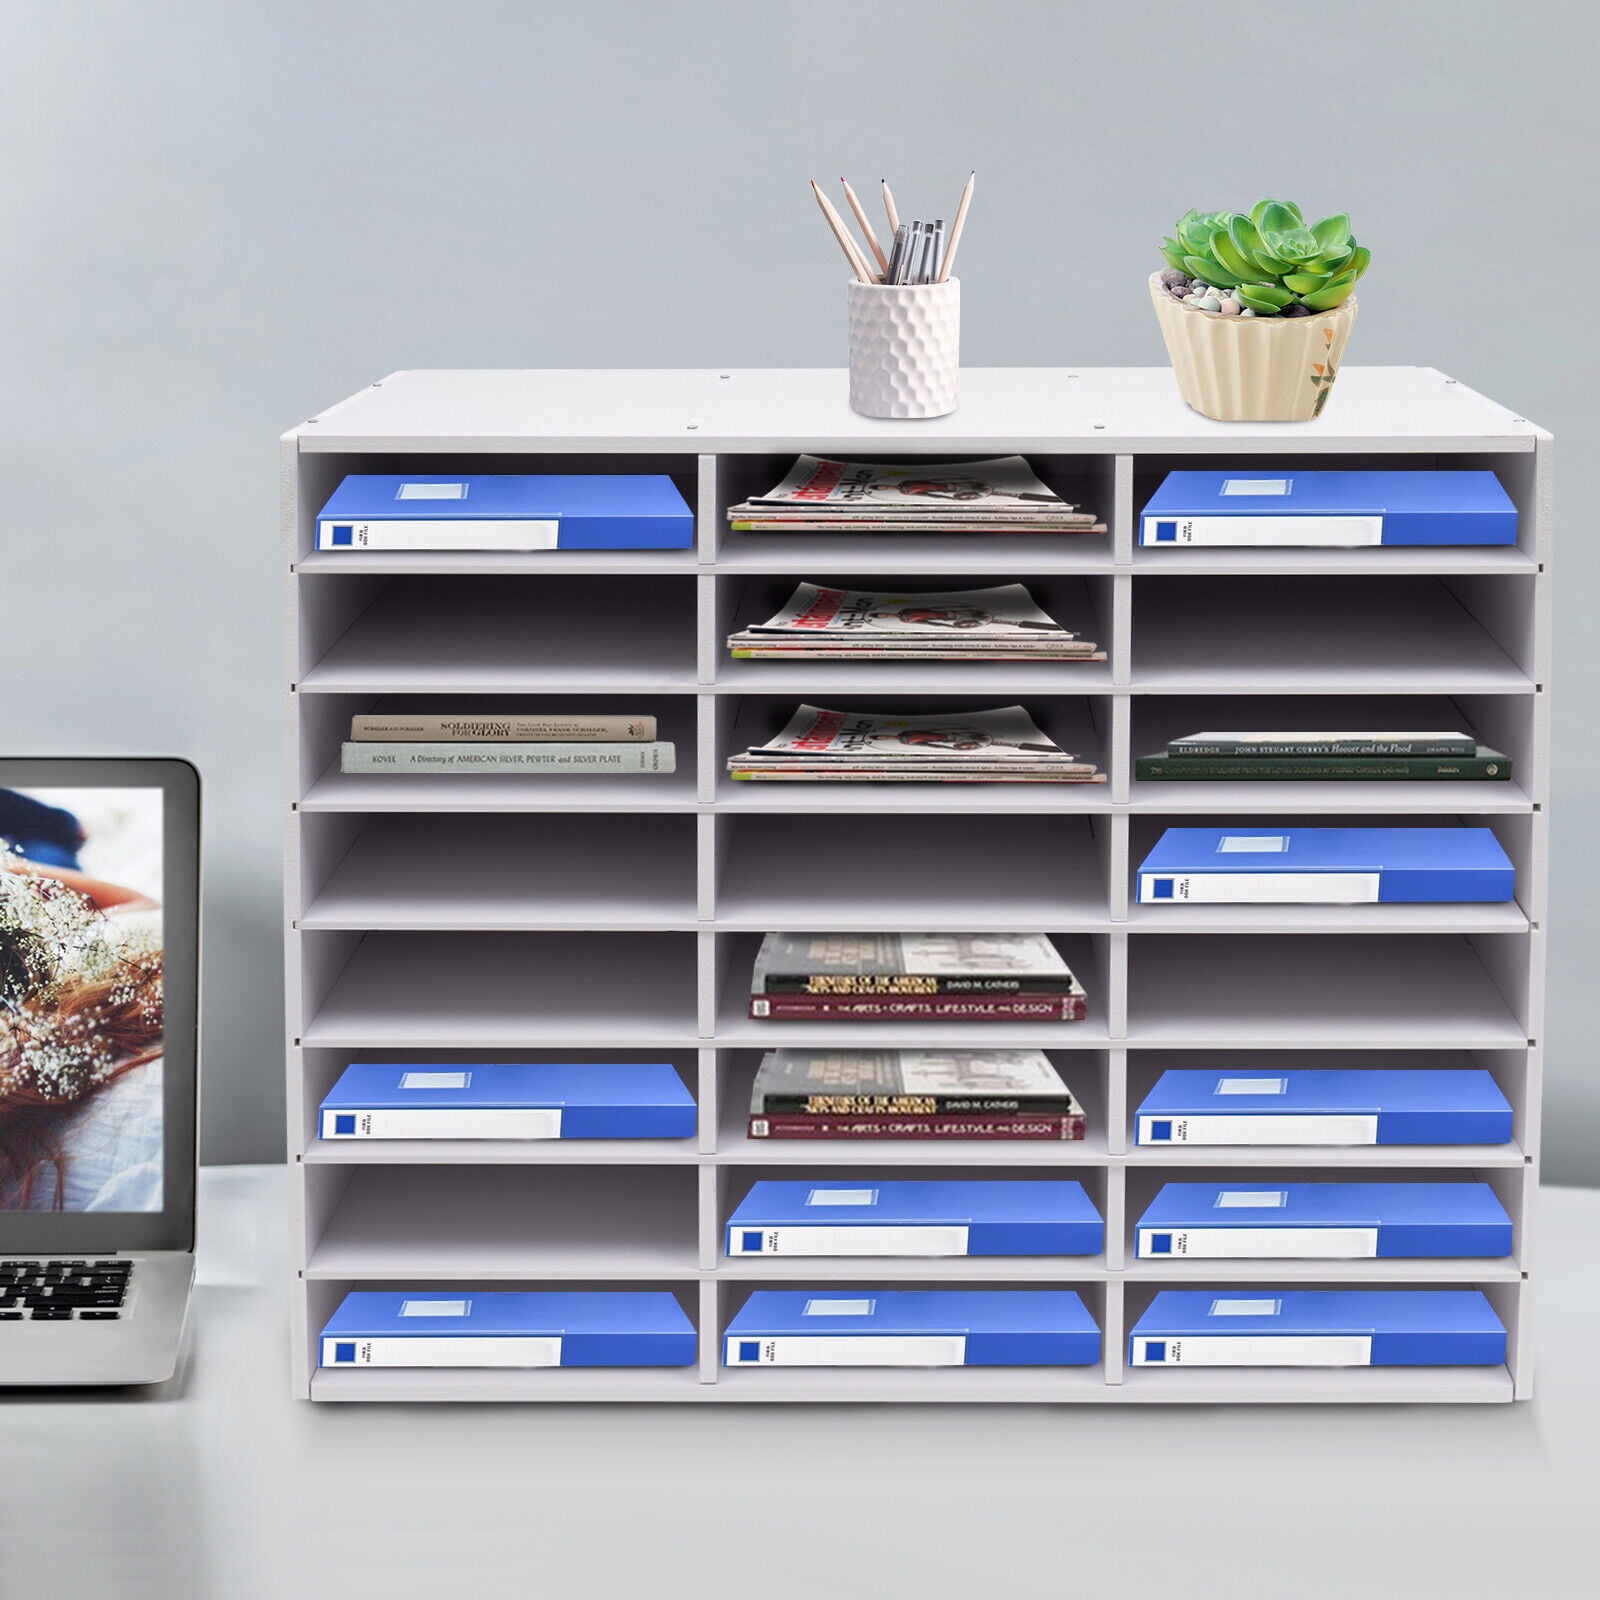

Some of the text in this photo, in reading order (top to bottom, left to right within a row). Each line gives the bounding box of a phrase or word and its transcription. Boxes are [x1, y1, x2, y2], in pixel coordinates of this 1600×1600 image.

[440, 722, 511, 730] SOLDIERING
[1360, 744, 1376, 753] and
[1376, 744, 1389, 753] the
[1390, 744, 1412, 753] Flood
[372, 755, 622, 764] KOVEL A Directory of AMERICAN SILVER, PEWTER and SILVER PLATE
[947, 981, 972, 989] DAVID
[852, 1004, 882, 1013] ARTS
[890, 1004, 932, 1013] CRAFTS
[936, 1004, 996, 1013] LIFESTYLE
[1013, 1004, 1054, 1013] DESIGN
[946, 1101, 970, 1109] DAVID
[851, 1124, 880, 1133] ARTS
[888, 1124, 931, 1133] CRAFTS
[935, 1124, 995, 1133] LIFESTYLE
[1012, 1124, 1052, 1133] DESIGN
